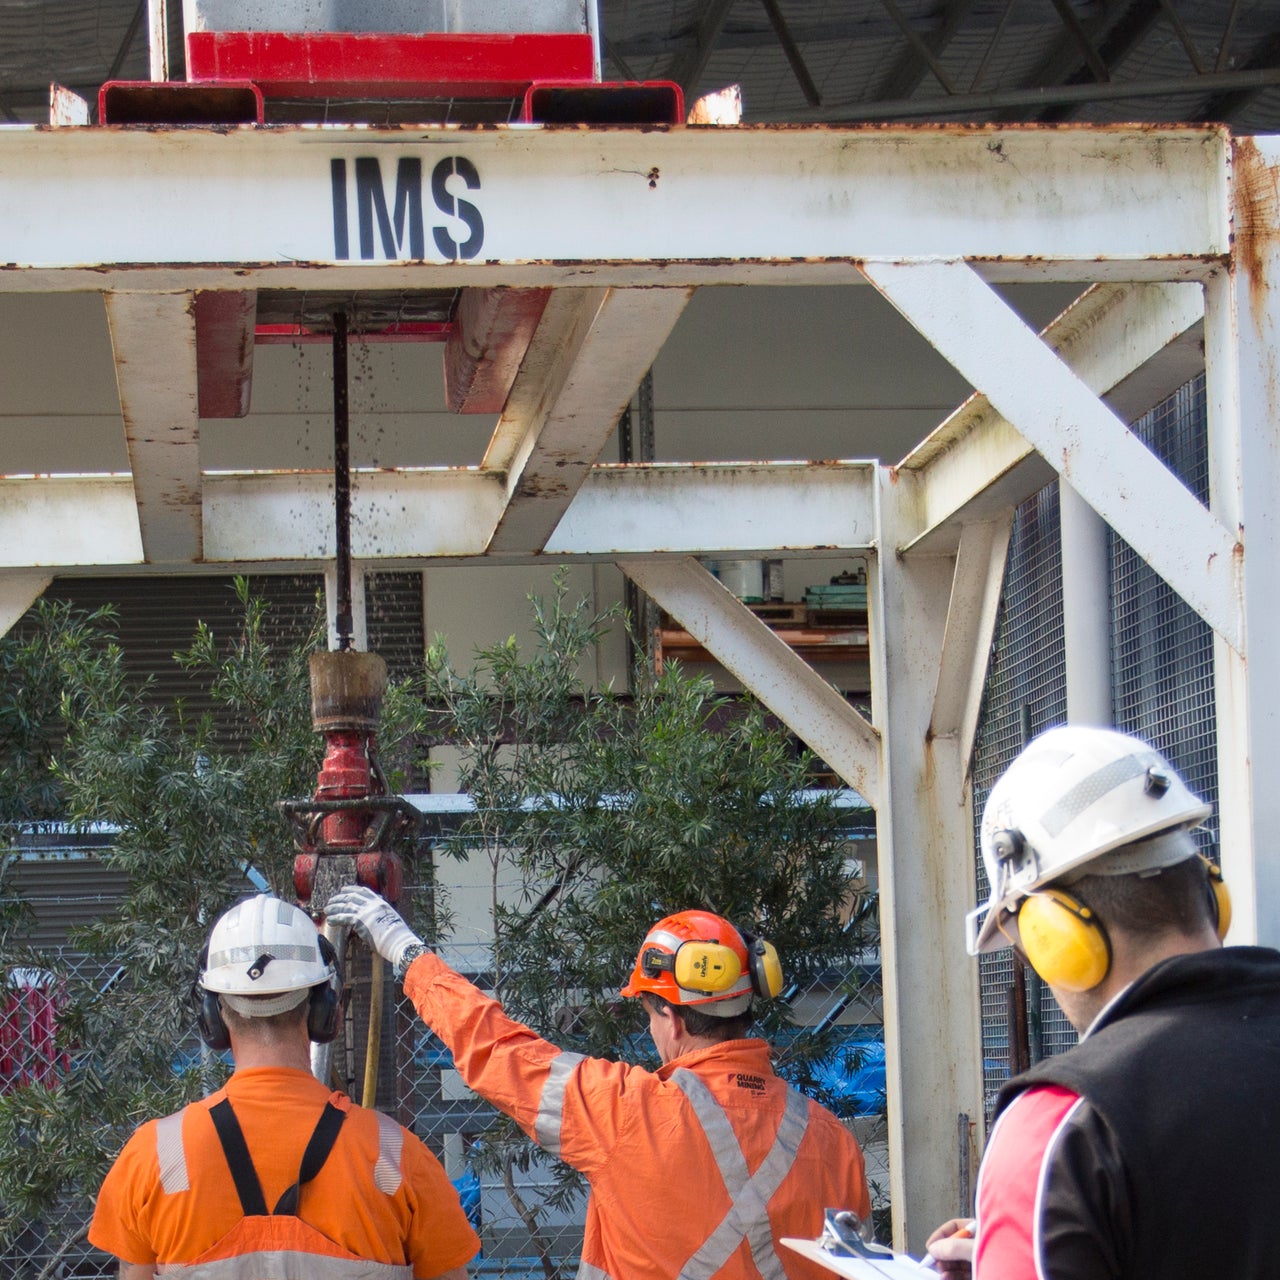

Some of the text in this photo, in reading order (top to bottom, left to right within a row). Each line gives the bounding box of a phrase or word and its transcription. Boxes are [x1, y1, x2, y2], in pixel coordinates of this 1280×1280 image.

[330, 156, 485, 260] IMS
[736, 1073, 766, 1085] QUARRY
[737, 1080, 766, 1091] MINING
